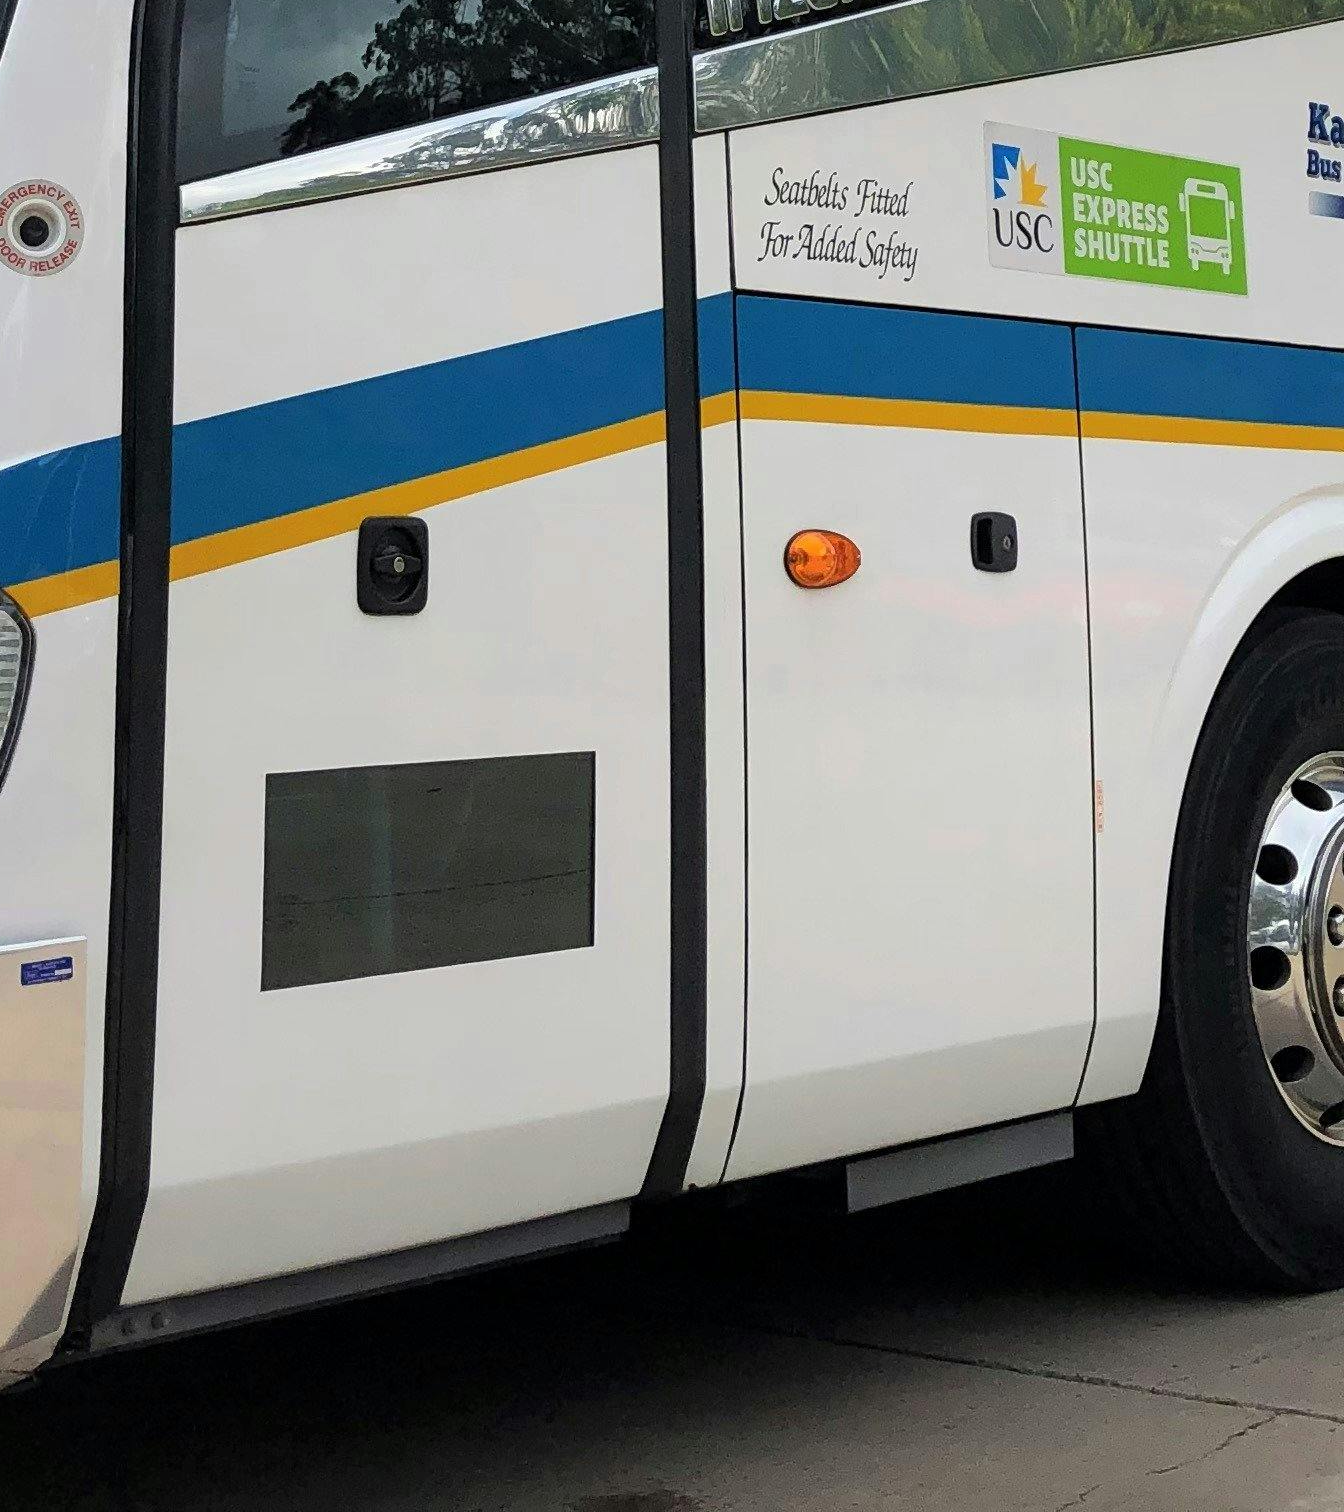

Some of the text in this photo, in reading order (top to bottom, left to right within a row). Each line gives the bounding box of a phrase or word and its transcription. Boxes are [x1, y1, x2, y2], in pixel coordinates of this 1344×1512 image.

[1069, 156, 1113, 188] USC
[1306, 148, 1341, 182] Bus
[763, 167, 915, 219] Seatbelts Fitted
[1072, 192, 1170, 235] EXPRESS
[62, 200, 80, 229] EXIT
[992, 207, 1055, 254] USC
[28, 238, 78, 272] RELEASE
[757, 220, 918, 282] For Added Safety
[1073, 228, 1171, 269] SHUTTLE
